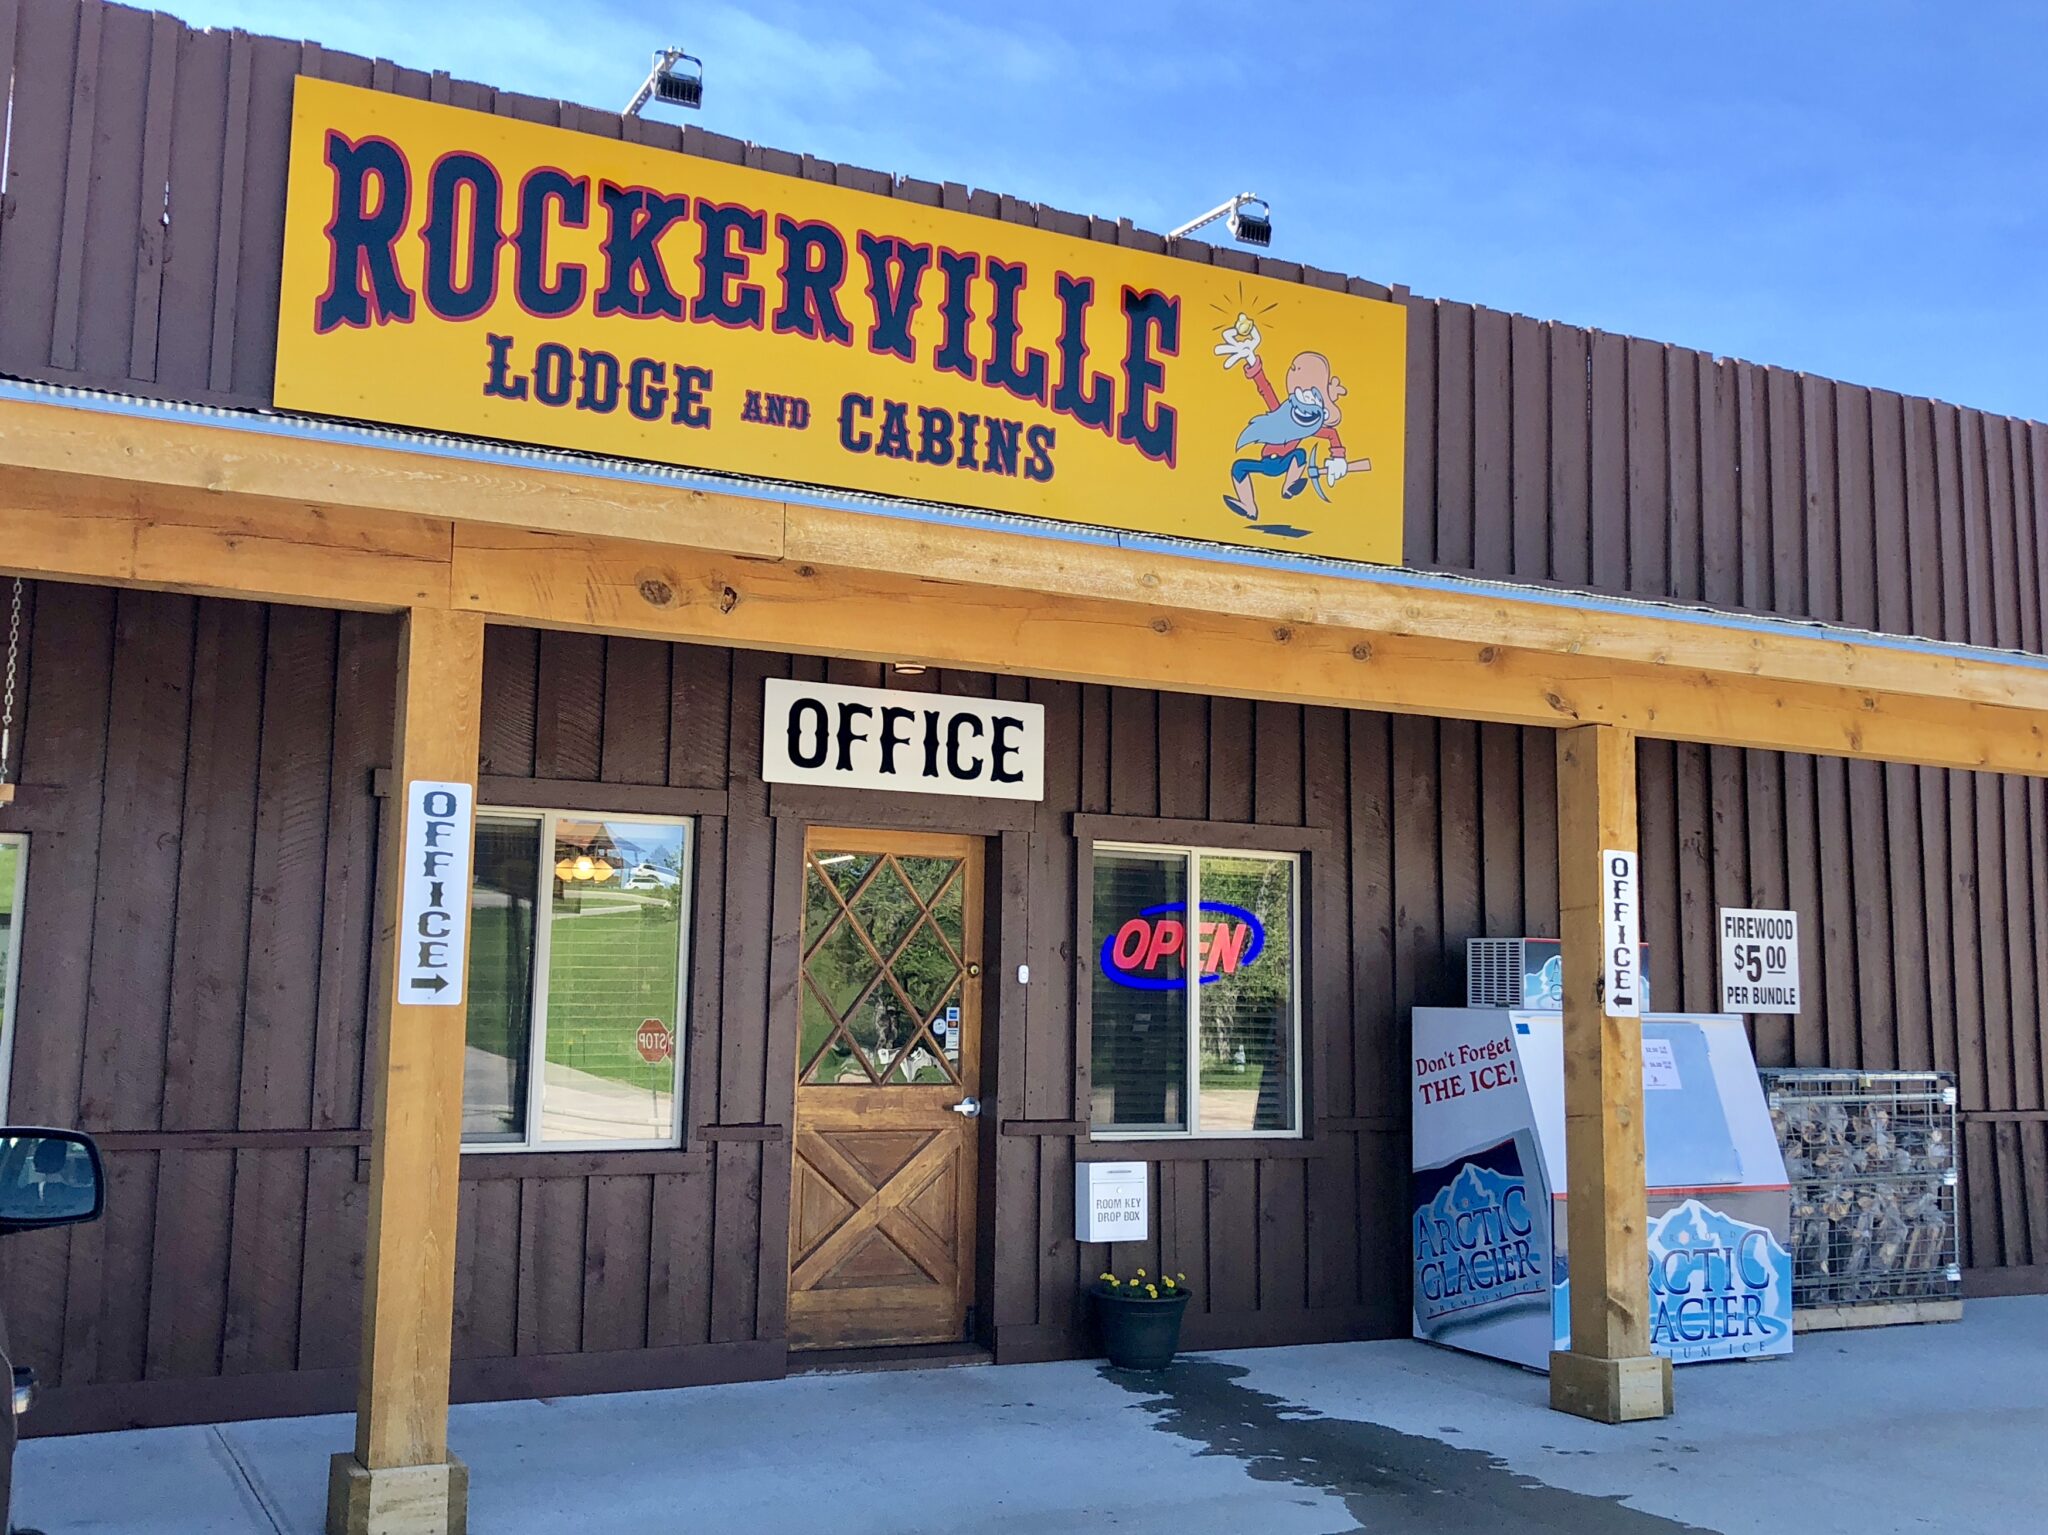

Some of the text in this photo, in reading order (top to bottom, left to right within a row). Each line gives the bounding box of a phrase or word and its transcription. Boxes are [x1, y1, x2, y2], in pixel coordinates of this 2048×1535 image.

[314, 129, 1180, 469] ROCKERVILLE
[483, 333, 1056, 482] LODGE AND CABINS
[787, 697, 1024, 783] OFFICE
[417, 790, 457, 968] OFFICE
[1112, 918, 1248, 974] OPEN
[1611, 857, 1631, 990] OFFICE
[1725, 916, 1793, 940] FIREWOOD
[1727, 986, 1796, 1005] PER BUNDLE
[1415, 1036, 1512, 1076] Don't Forget
[1418, 1060, 1518, 1105] THE ICE!
[1096, 1197, 1142, 1210] ROOM KEY
[1097, 1210, 1140, 1223] DROP BOX
[1416, 1185, 1532, 1261] ARCTIC
[1421, 1239, 1542, 1302] GLACIER
[1650, 1294, 1772, 1344] ACIER
[1729, 1341, 1767, 1355] ICE
